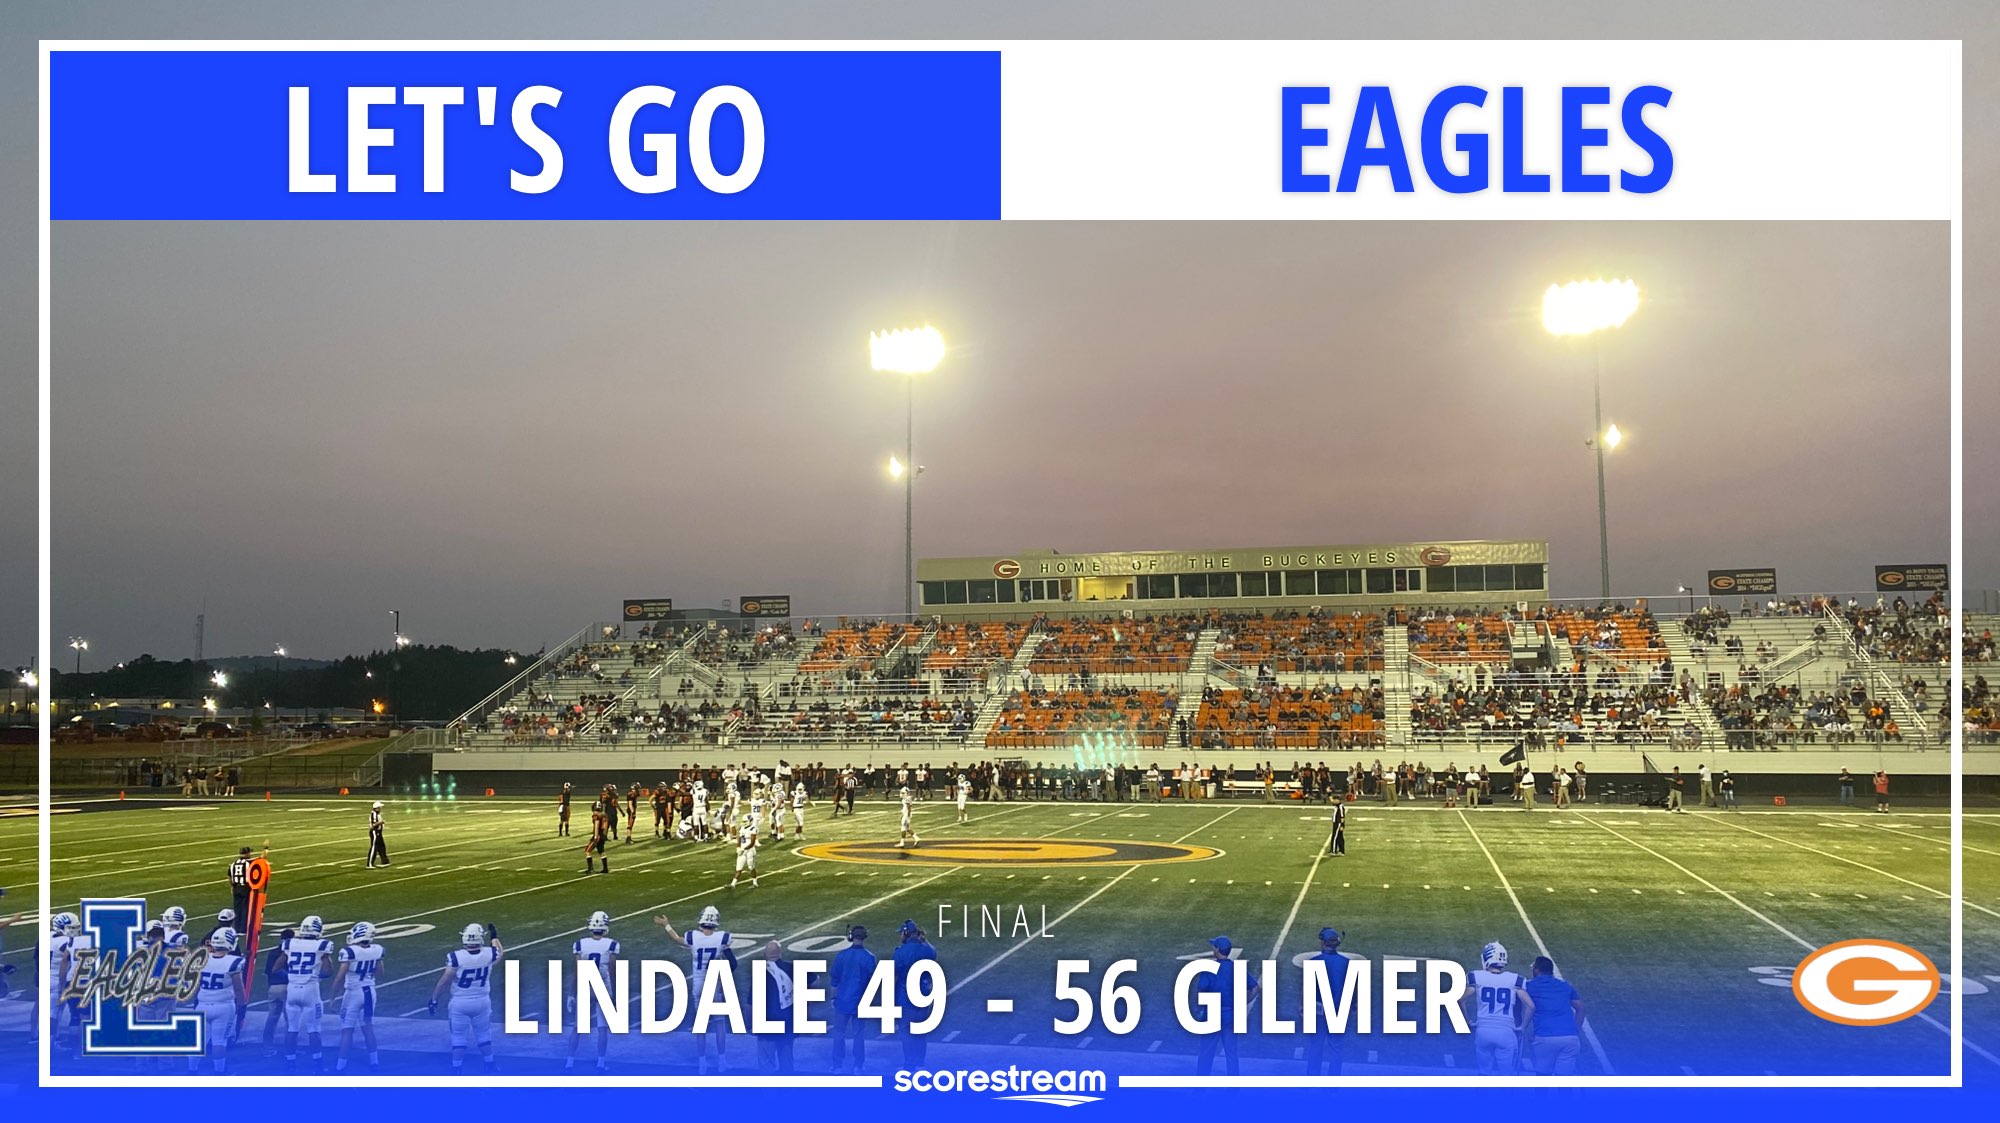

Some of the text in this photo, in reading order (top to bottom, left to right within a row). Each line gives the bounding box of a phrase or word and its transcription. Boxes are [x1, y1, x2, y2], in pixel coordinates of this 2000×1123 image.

[1040, 551, 1397, 574] HOME OF THE BUCKEYES
[234, 864, 243, 876] H
[287, 951, 317, 975] 22
[355, 959, 380, 982] 44
[695, 947, 718, 971] 17
[457, 966, 489, 989] 64
[1480, 986, 1512, 1016] 99
